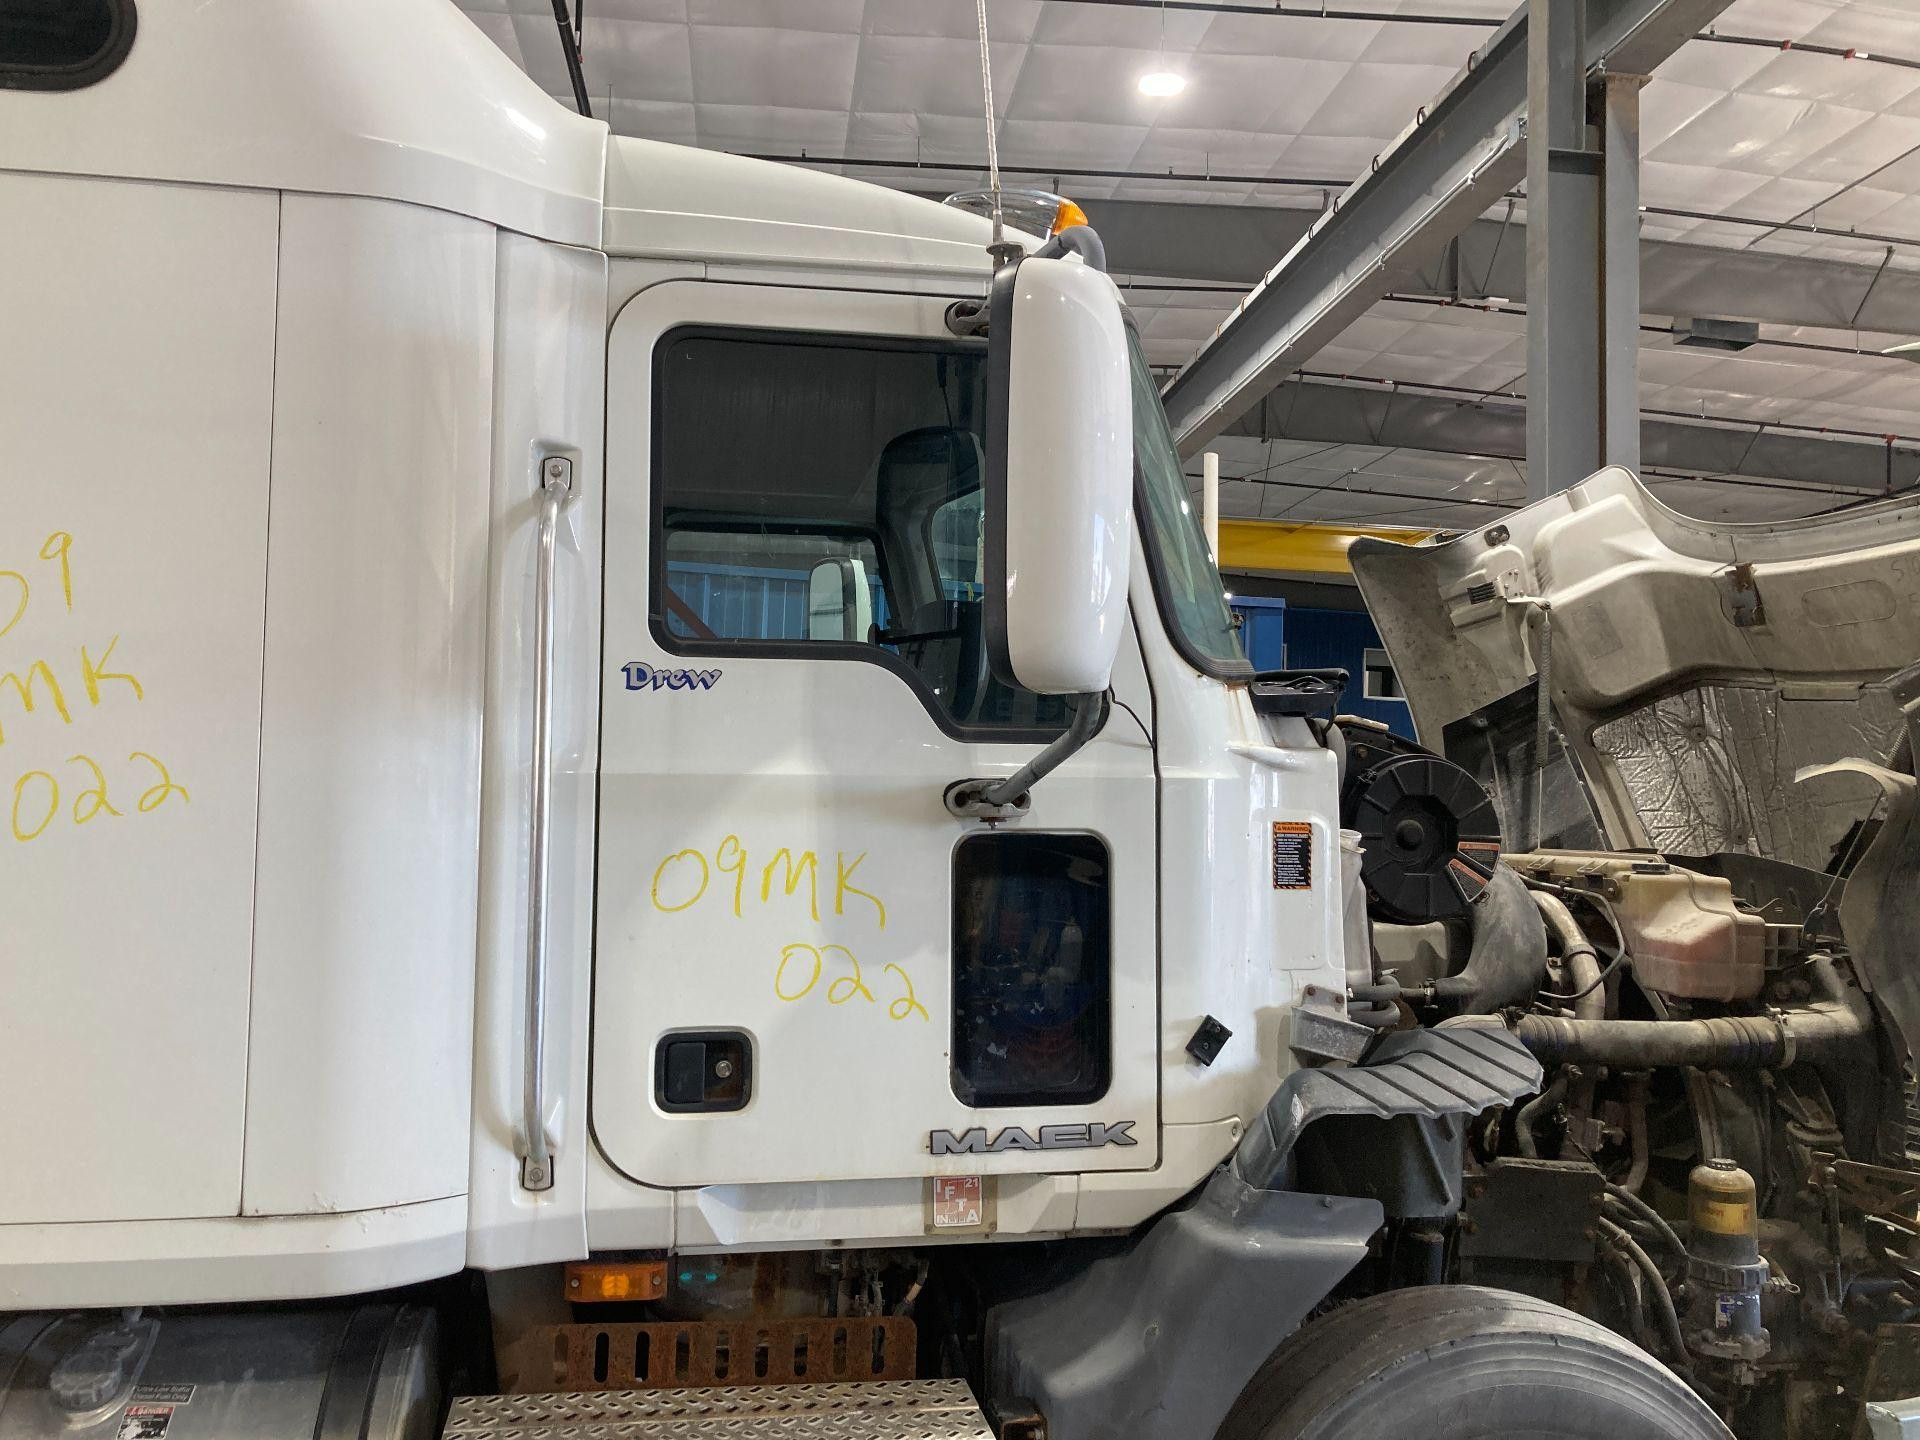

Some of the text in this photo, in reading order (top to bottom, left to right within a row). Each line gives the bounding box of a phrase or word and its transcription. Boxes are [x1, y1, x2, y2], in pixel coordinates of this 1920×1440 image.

[621, 661, 722, 691] Drew
[12, 752, 189, 841] 022
[775, 943, 930, 1022] 022
[930, 1121, 1138, 1154] MACK
[965, 1178, 978, 1188] 21
